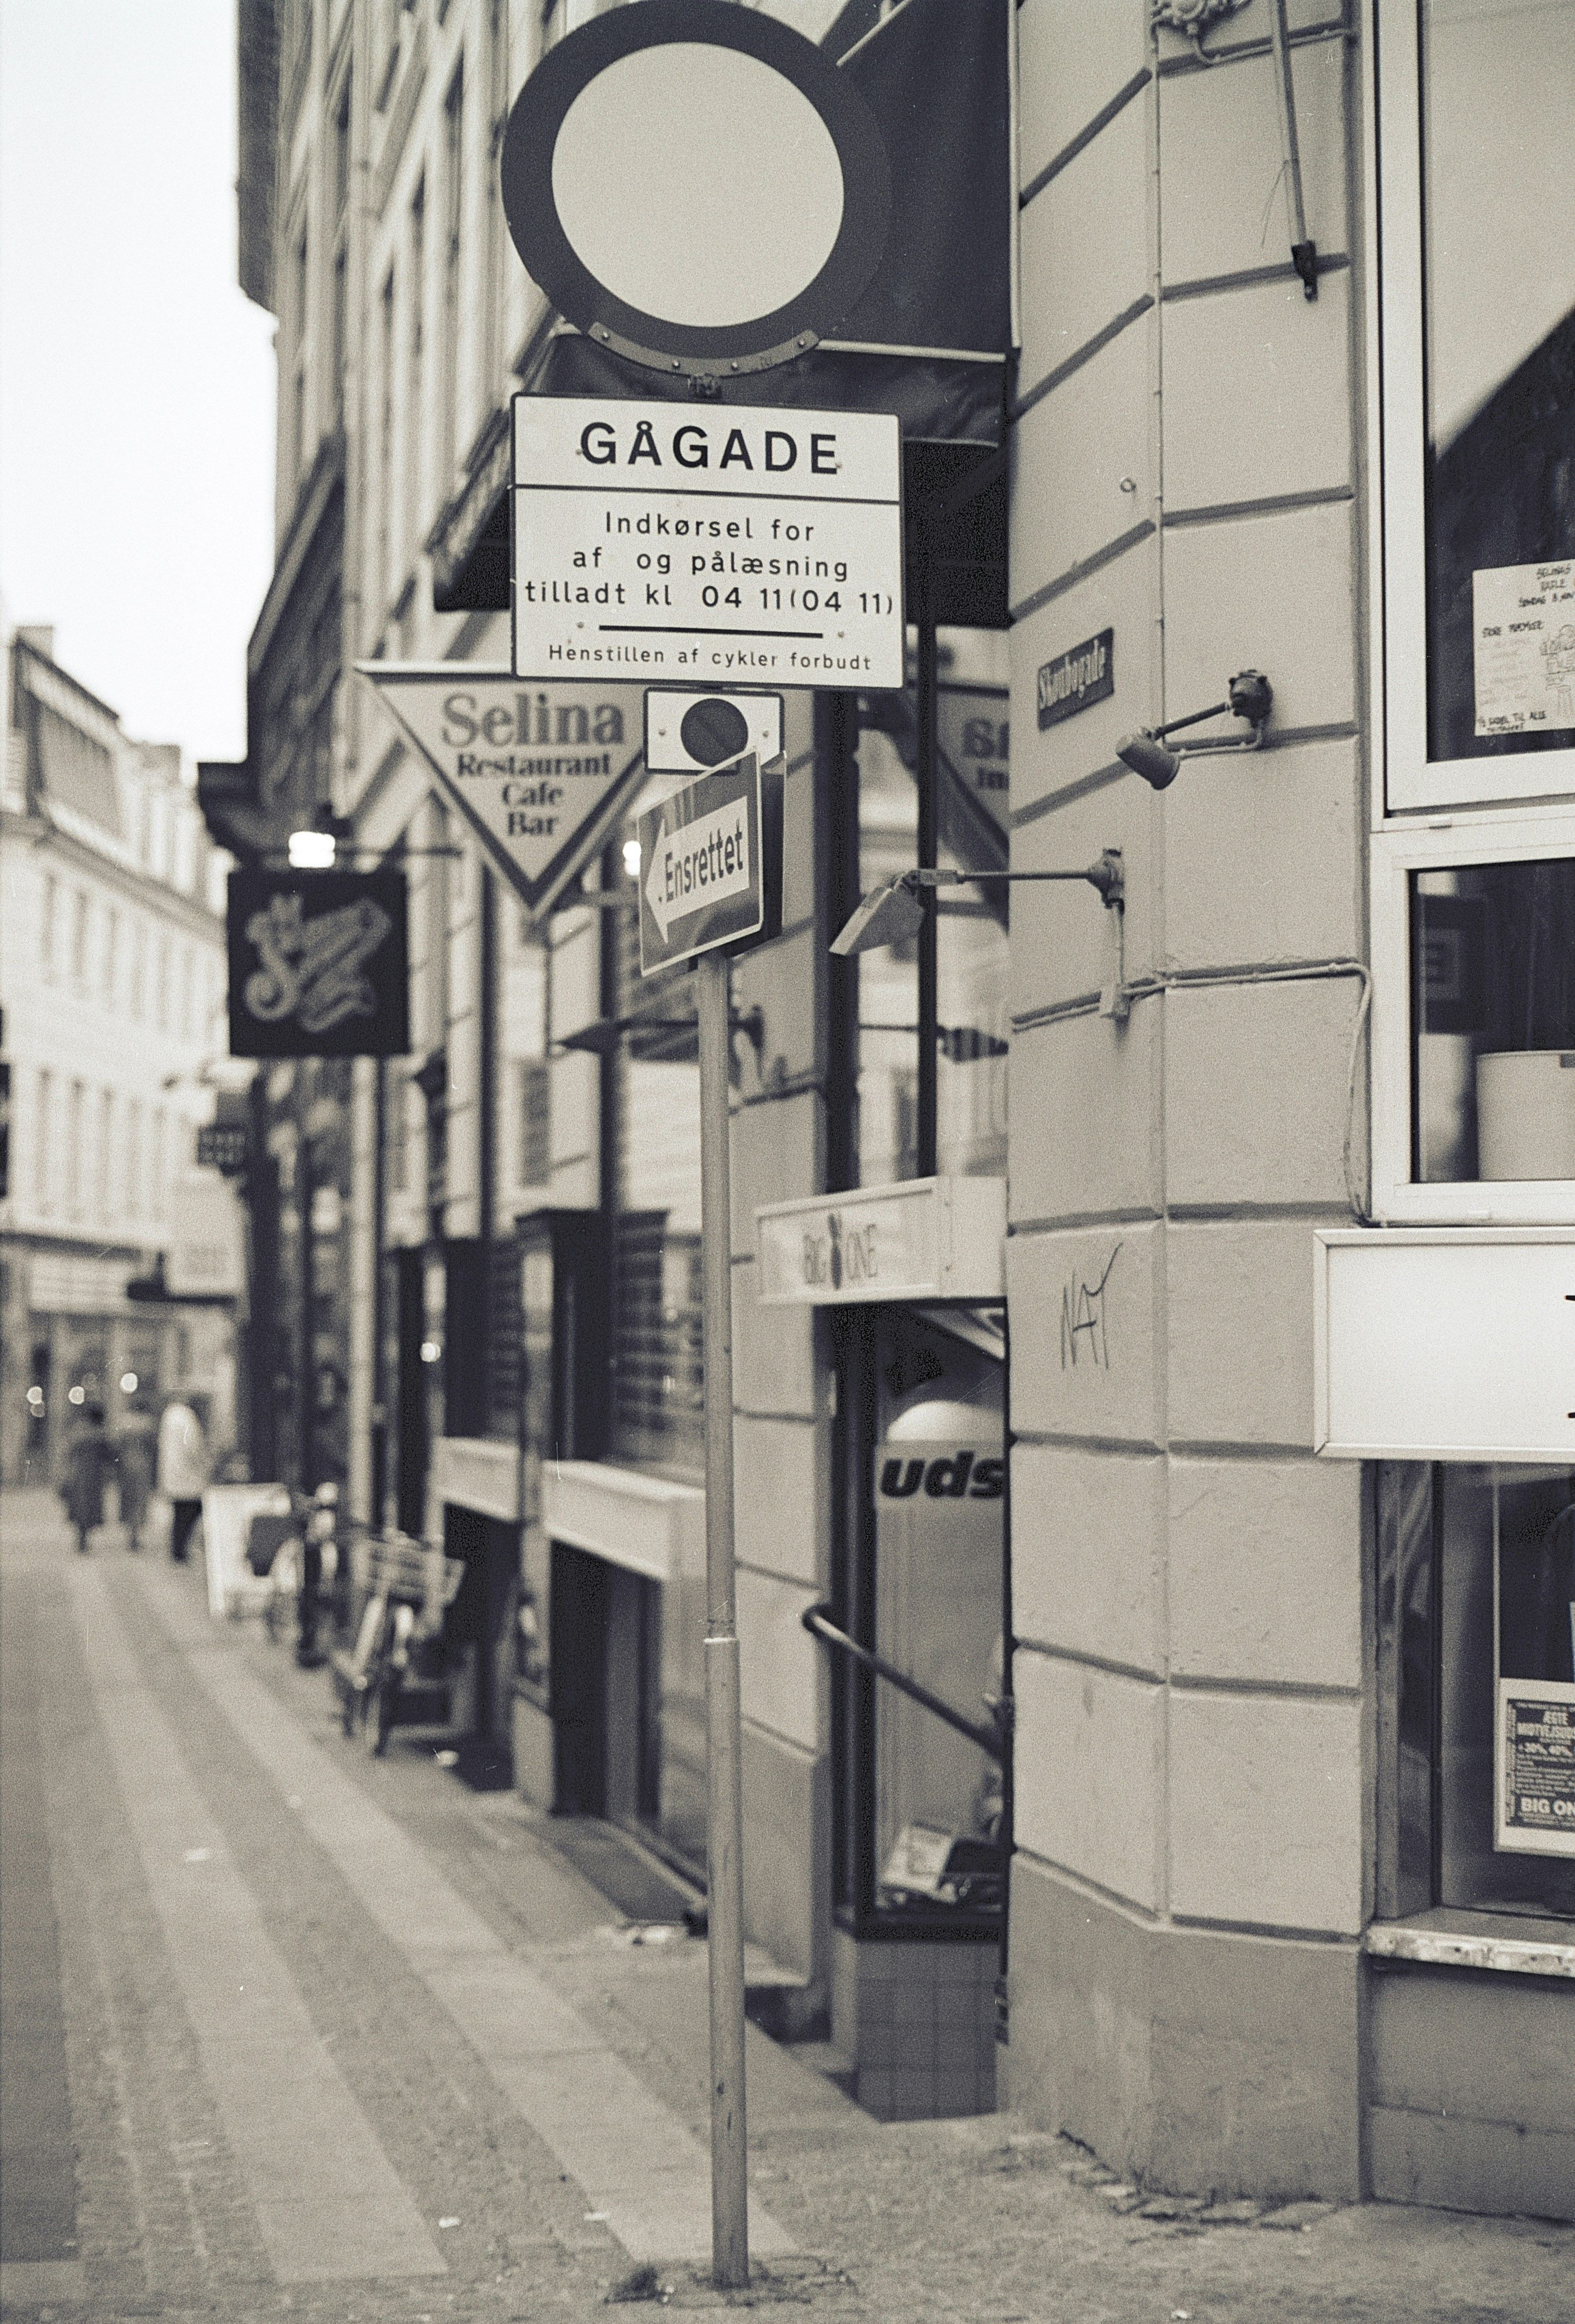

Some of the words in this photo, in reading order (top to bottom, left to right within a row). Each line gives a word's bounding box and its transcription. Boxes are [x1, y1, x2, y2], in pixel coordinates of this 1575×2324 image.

[581, 421, 837, 474] GÅGADE
[606, 512, 753, 539] Indkørsel
[771, 518, 814, 541] for
[573, 546, 602, 568] af
[637, 553, 671, 575] og
[692, 551, 848, 582] pålæsning
[525, 581, 625, 604] tilladt
[549, 645, 664, 663] Henstillen
[678, 648, 698, 663] af
[711, 650, 778, 668] cykler
[790, 652, 871, 670] forbudt
[442, 692, 624, 748] Selina
[457, 753, 610, 776] Restaurant
[502, 782, 563, 805] Cafe
[508, 812, 557, 835] Bar
[664, 819, 744, 903] Ensrettet
[1522, 1797, 1550, 1814] BIG
